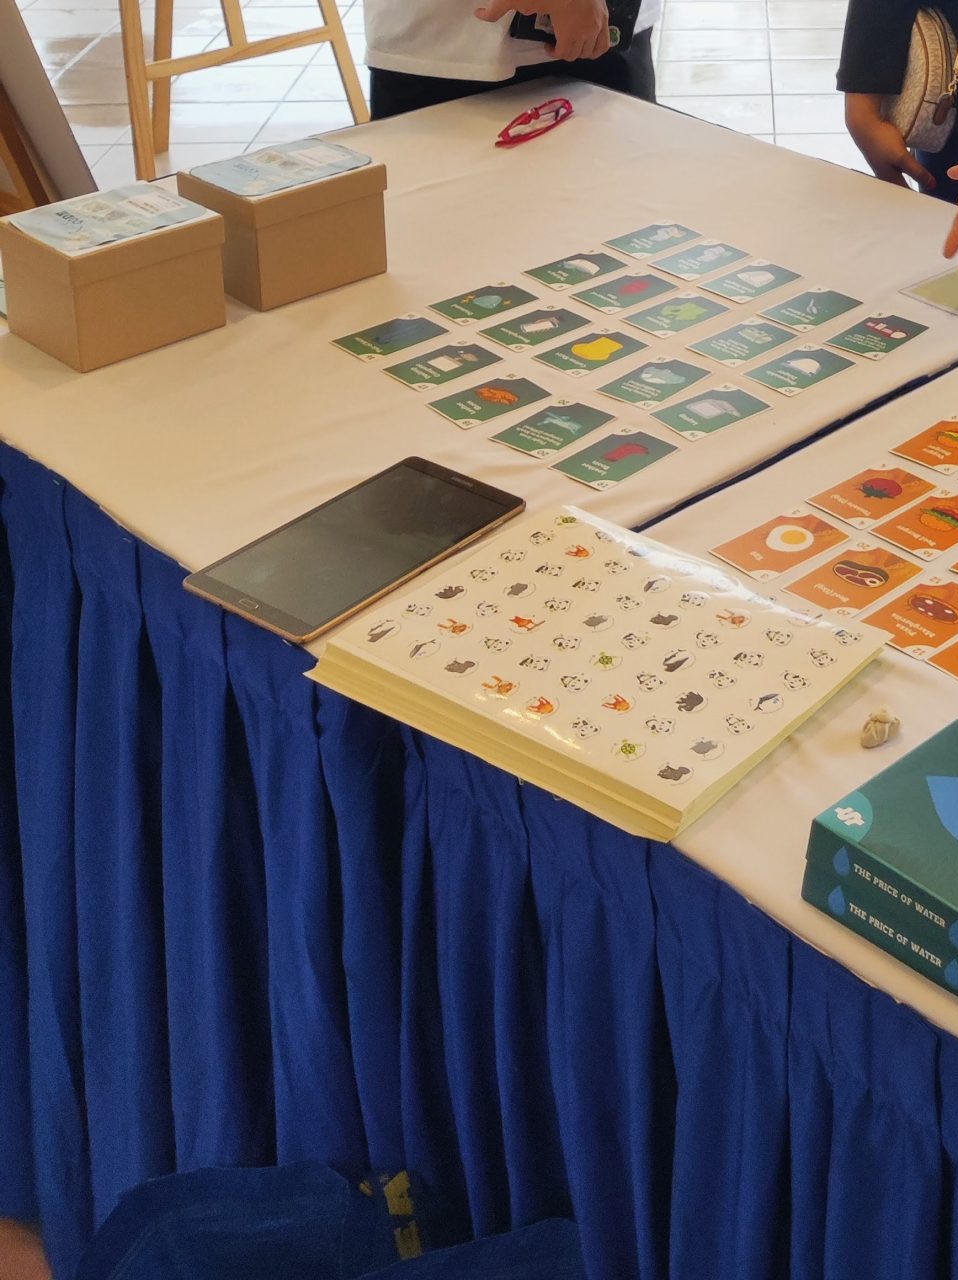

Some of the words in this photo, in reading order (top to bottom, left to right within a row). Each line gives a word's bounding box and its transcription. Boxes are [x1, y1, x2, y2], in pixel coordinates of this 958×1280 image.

[853, 863, 870, 881] THE
[872, 872, 899, 899] PRICE
[900, 892, 914, 906] OF
[914, 900, 946, 929] WATER
[849, 902, 866, 920] THE
[868, 912, 895, 939] PRICE
[896, 932, 909, 946] OF
[910, 940, 943, 969] WATER
